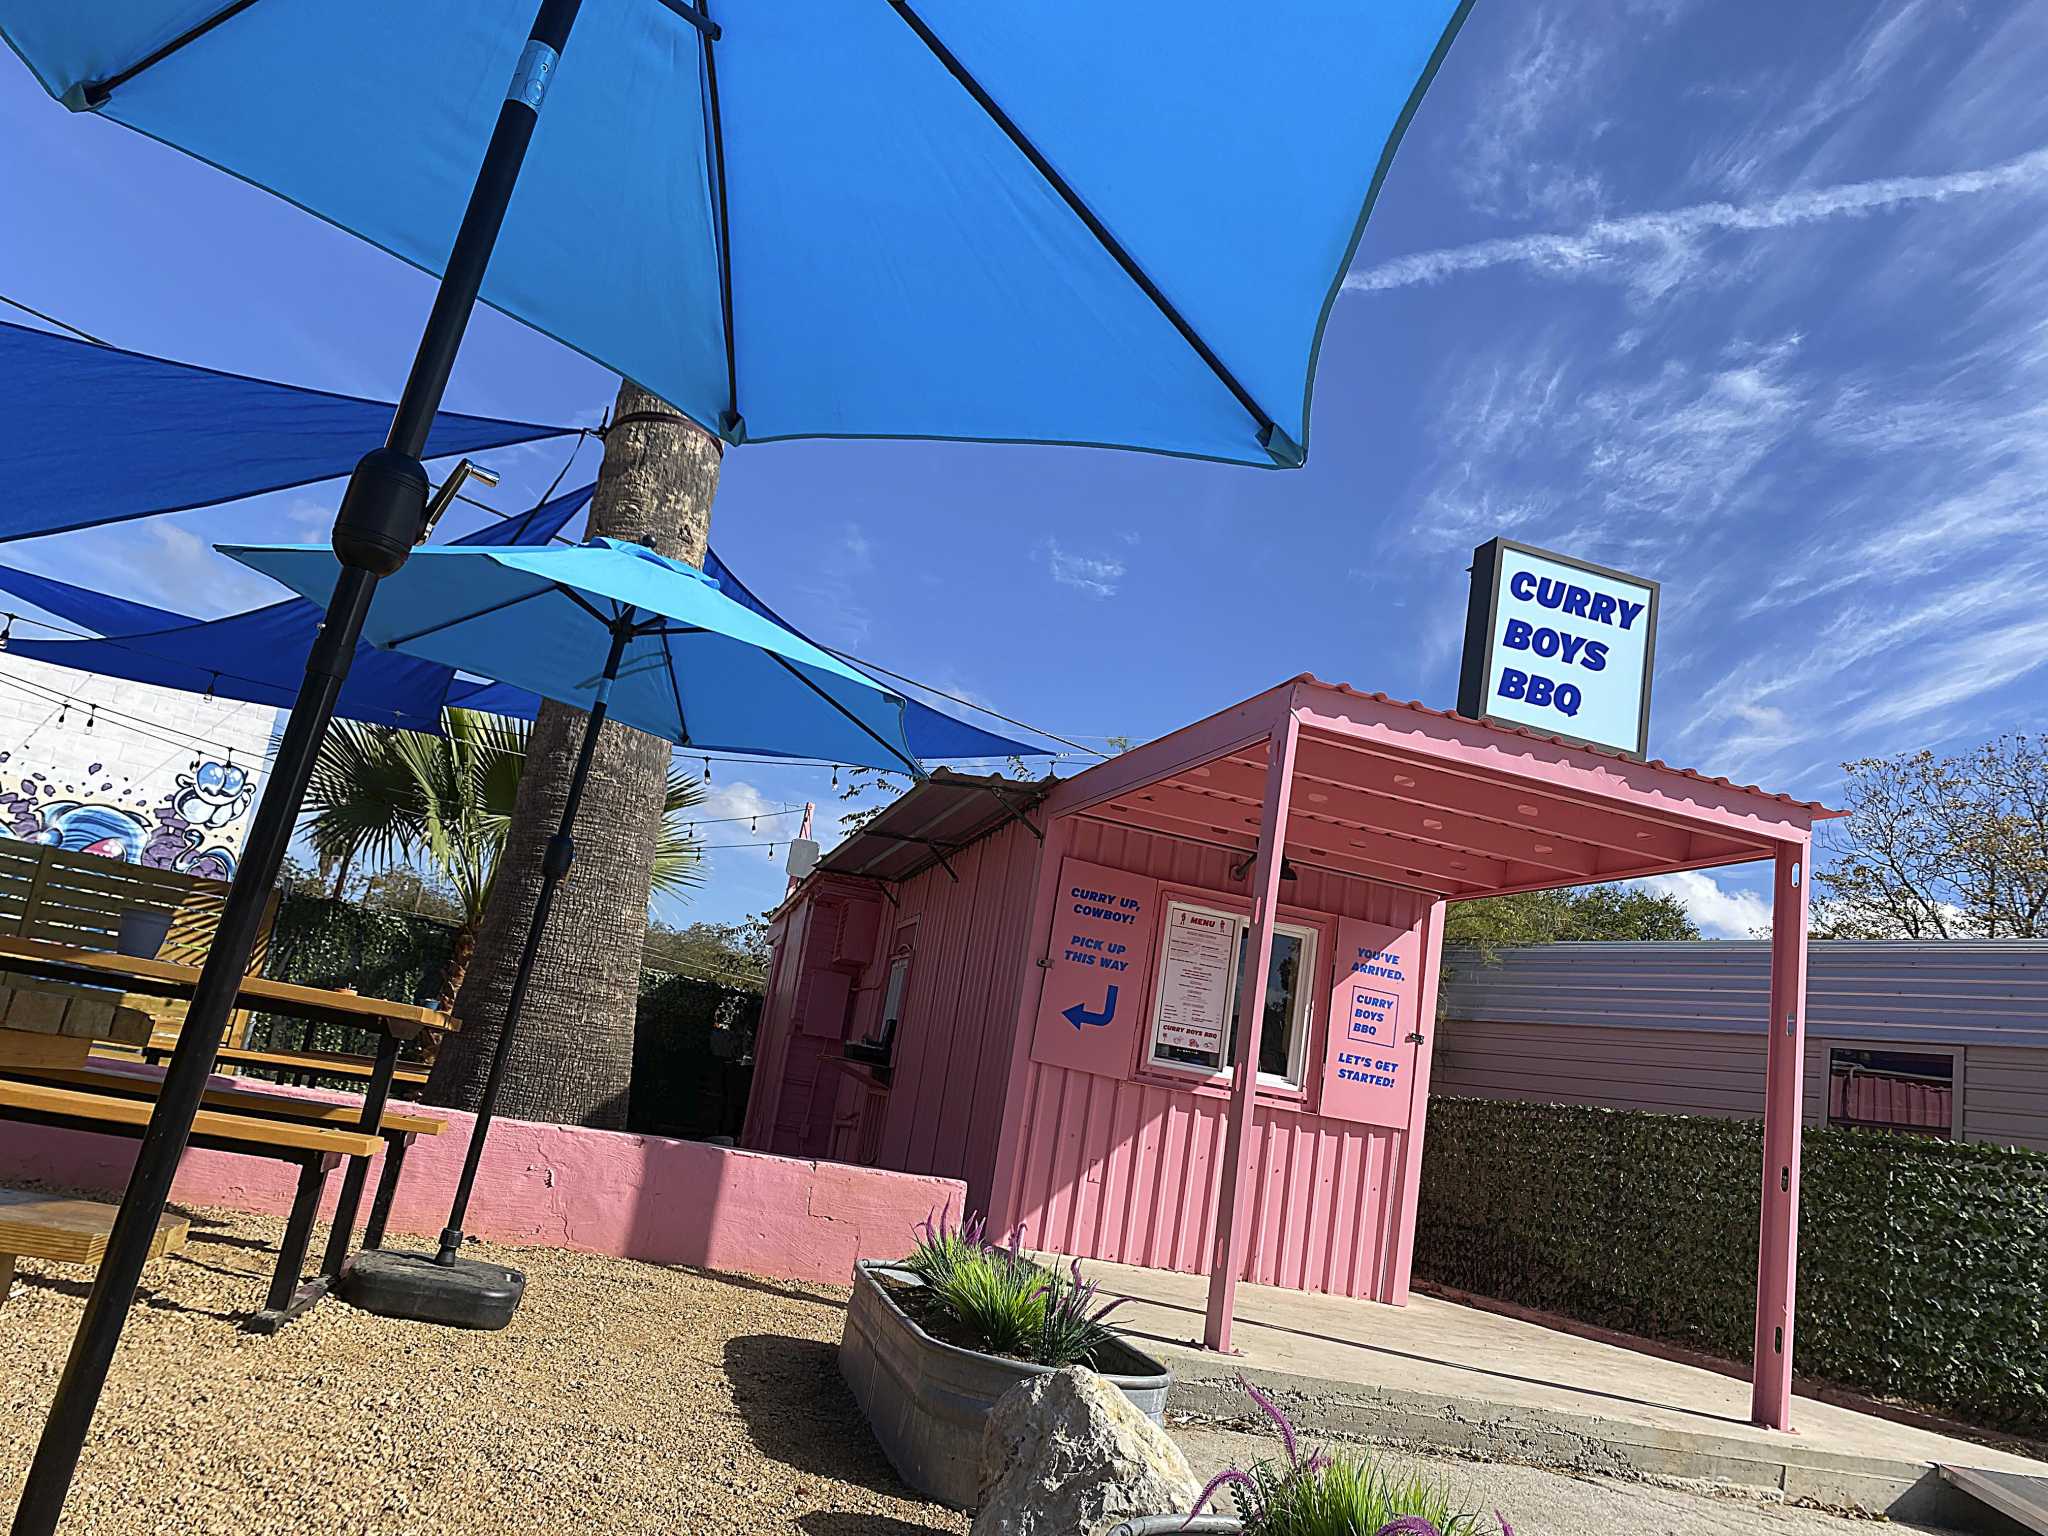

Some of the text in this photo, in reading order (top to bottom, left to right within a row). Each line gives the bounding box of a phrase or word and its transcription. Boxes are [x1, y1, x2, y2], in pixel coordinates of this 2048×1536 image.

[1510, 571, 1645, 631] CURRY
[1502, 618, 1610, 672] BOYS
[1497, 667, 1582, 718] BBQ
[1071, 887, 1116, 905] CURRY
[1073, 904, 1136, 925] COWBOY!
[1190, 916, 1216, 928] MENU
[1070, 935, 1127, 955] PICK UP
[1064, 950, 1129, 972] THIS WAY
[1357, 947, 1400, 965] YOU'VE
[1351, 962, 1405, 982] ARRIVED.
[1356, 994, 1395, 1010] CURRY
[1354, 1008, 1385, 1023] BOYS
[1163, 1024, 1218, 1039] CURRY BOYS BBQ
[1353, 1022, 1377, 1036] BBQ
[1338, 1052, 1399, 1073] LET'S GET
[1337, 1068, 1395, 1088] STARTED!
